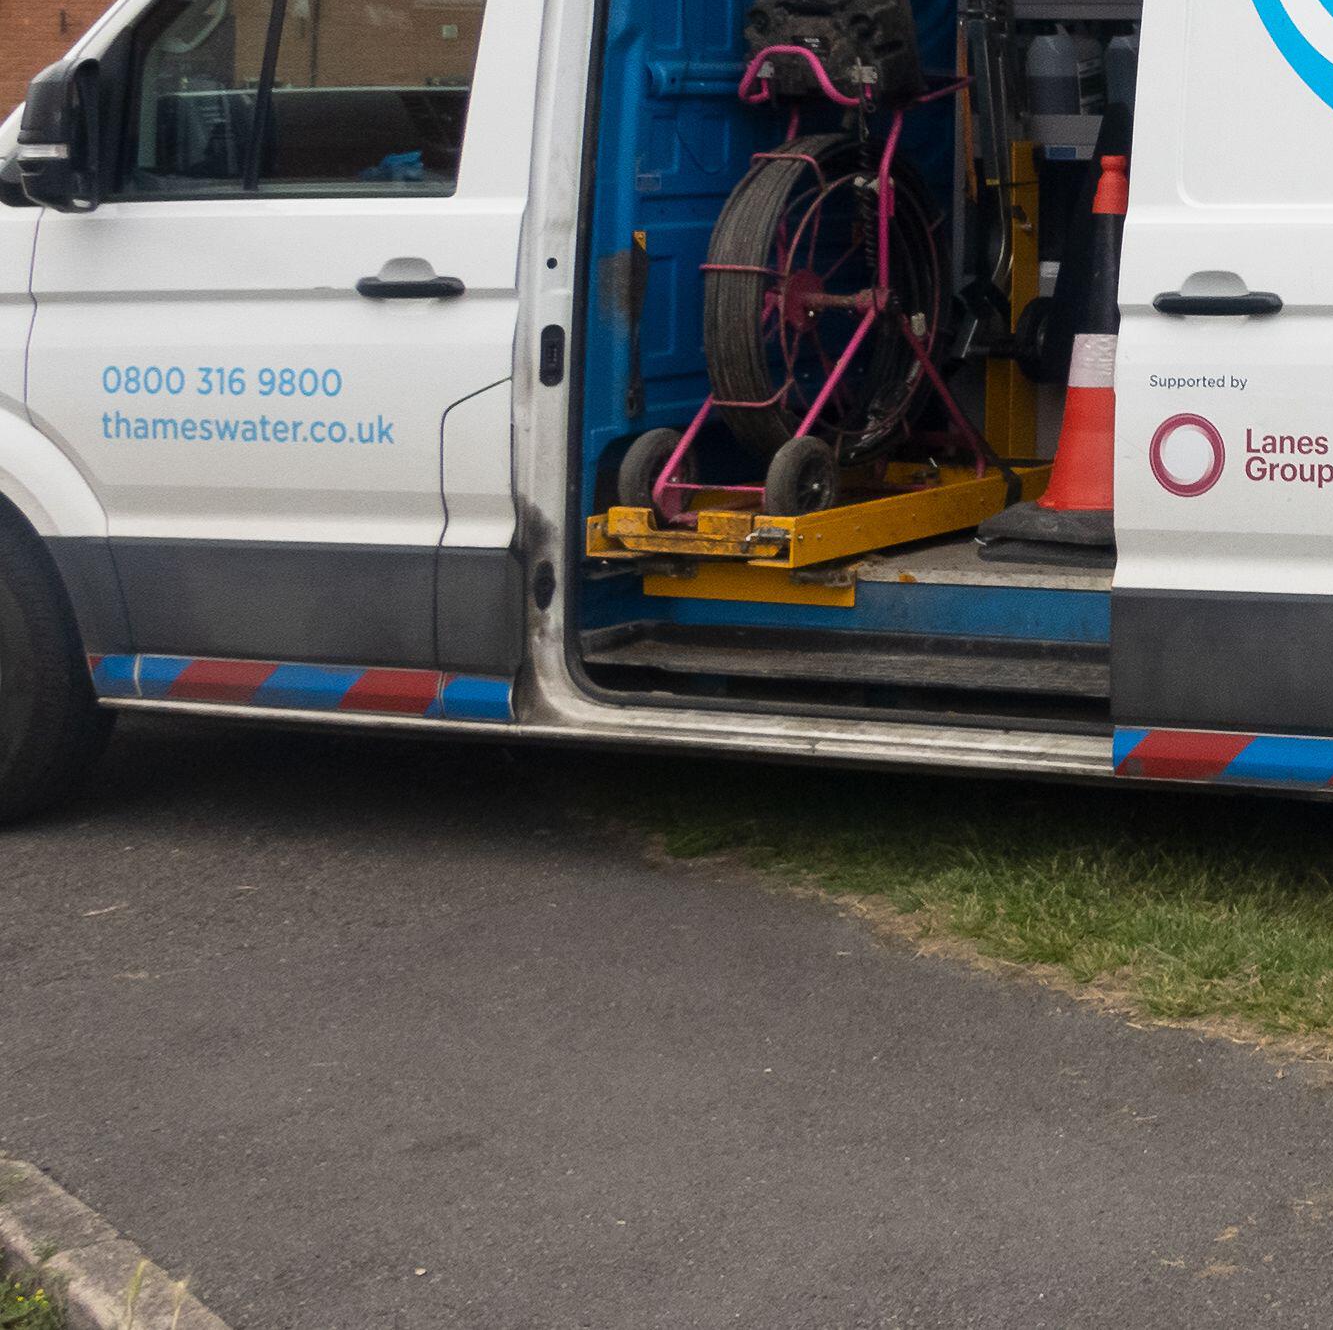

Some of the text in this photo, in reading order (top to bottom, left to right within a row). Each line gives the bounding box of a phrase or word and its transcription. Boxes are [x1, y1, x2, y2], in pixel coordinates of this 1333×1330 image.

[102, 365, 343, 398] 0800 316 9800
[1149, 375, 1248, 391] Supported by
[101, 412, 394, 445] thameswater.co.uk
[1246, 428, 1329, 455] Lanes
